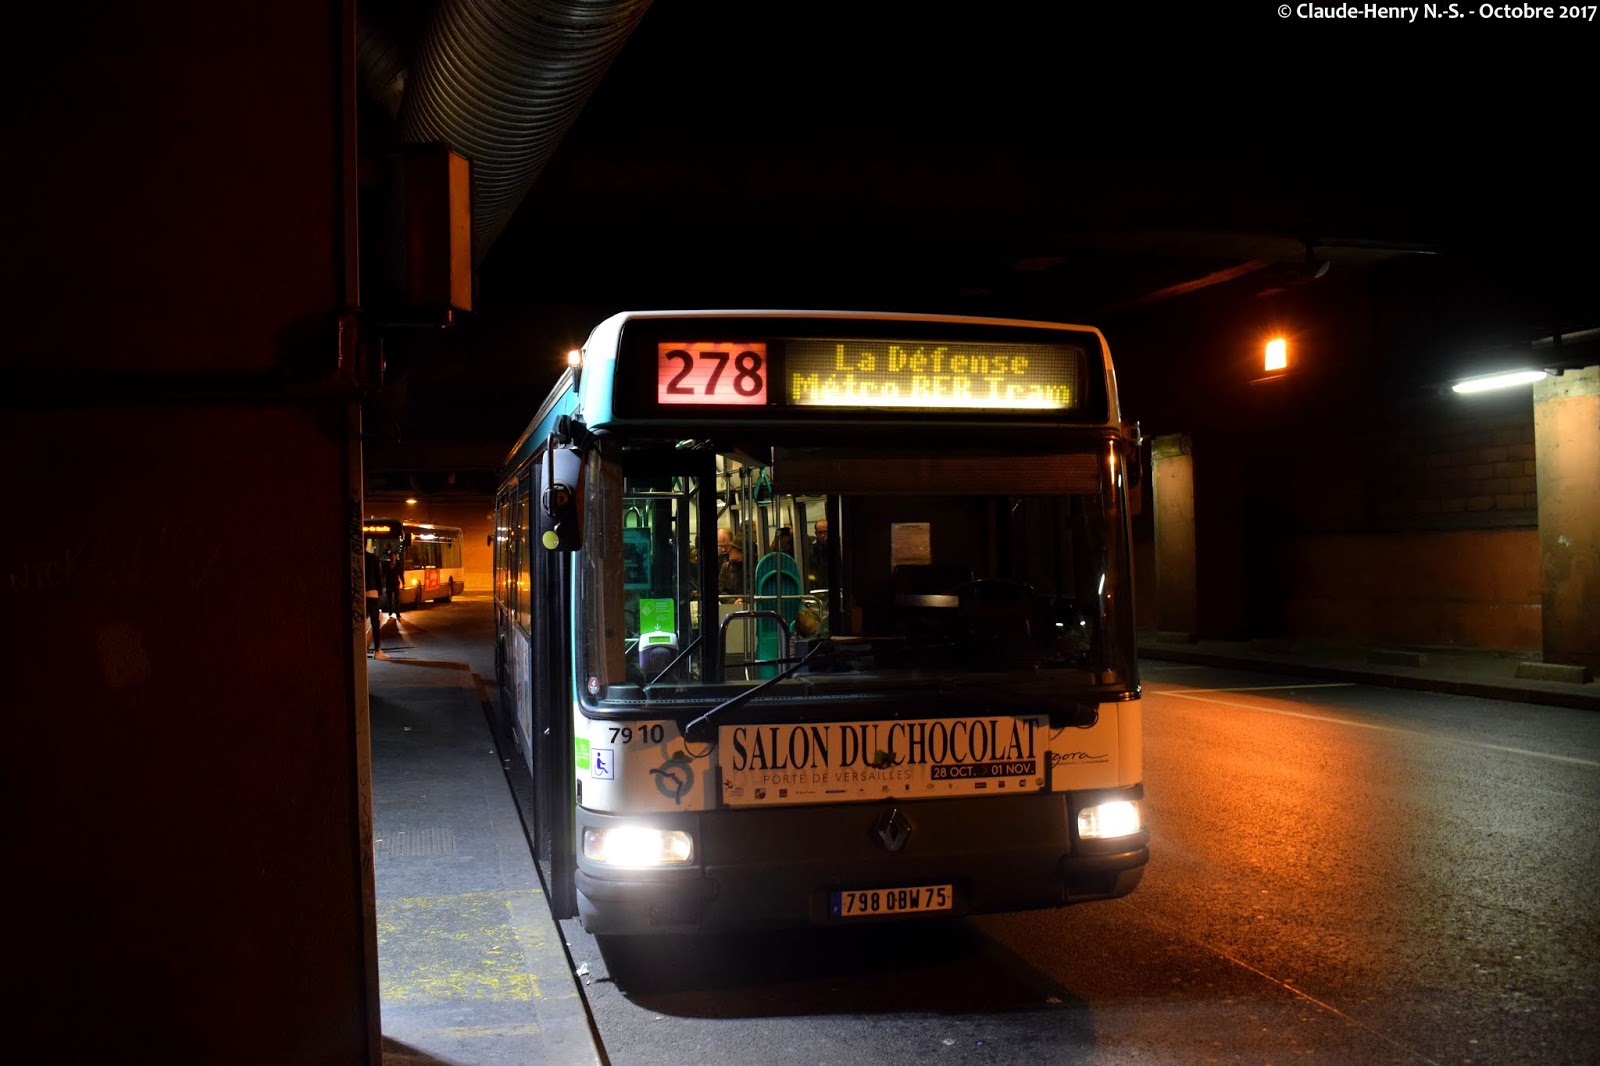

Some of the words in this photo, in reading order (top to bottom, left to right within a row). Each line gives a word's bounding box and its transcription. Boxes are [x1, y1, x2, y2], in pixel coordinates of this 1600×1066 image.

[835, 344, 876, 372] La
[889, 345, 1029, 375] Défense
[665, 349, 763, 398] 278
[732, 726, 831, 771] SALON
[839, 724, 881, 769] DU
[887, 718, 1039, 766] CHOCOLAT
[933, 767, 947, 779] 28
[950, 765, 977, 777] OCT.
[991, 765, 1003, 776] 01
[1006, 763, 1035, 775] NOV.
[1051, 750, 1109, 770] gora
[763, 774, 807, 785] PORTE
[812, 772, 829, 783] DE
[834, 769, 912, 783] VERSAILLES
[846, 892, 880, 913] 798
[925, 887, 946, 908] 75
